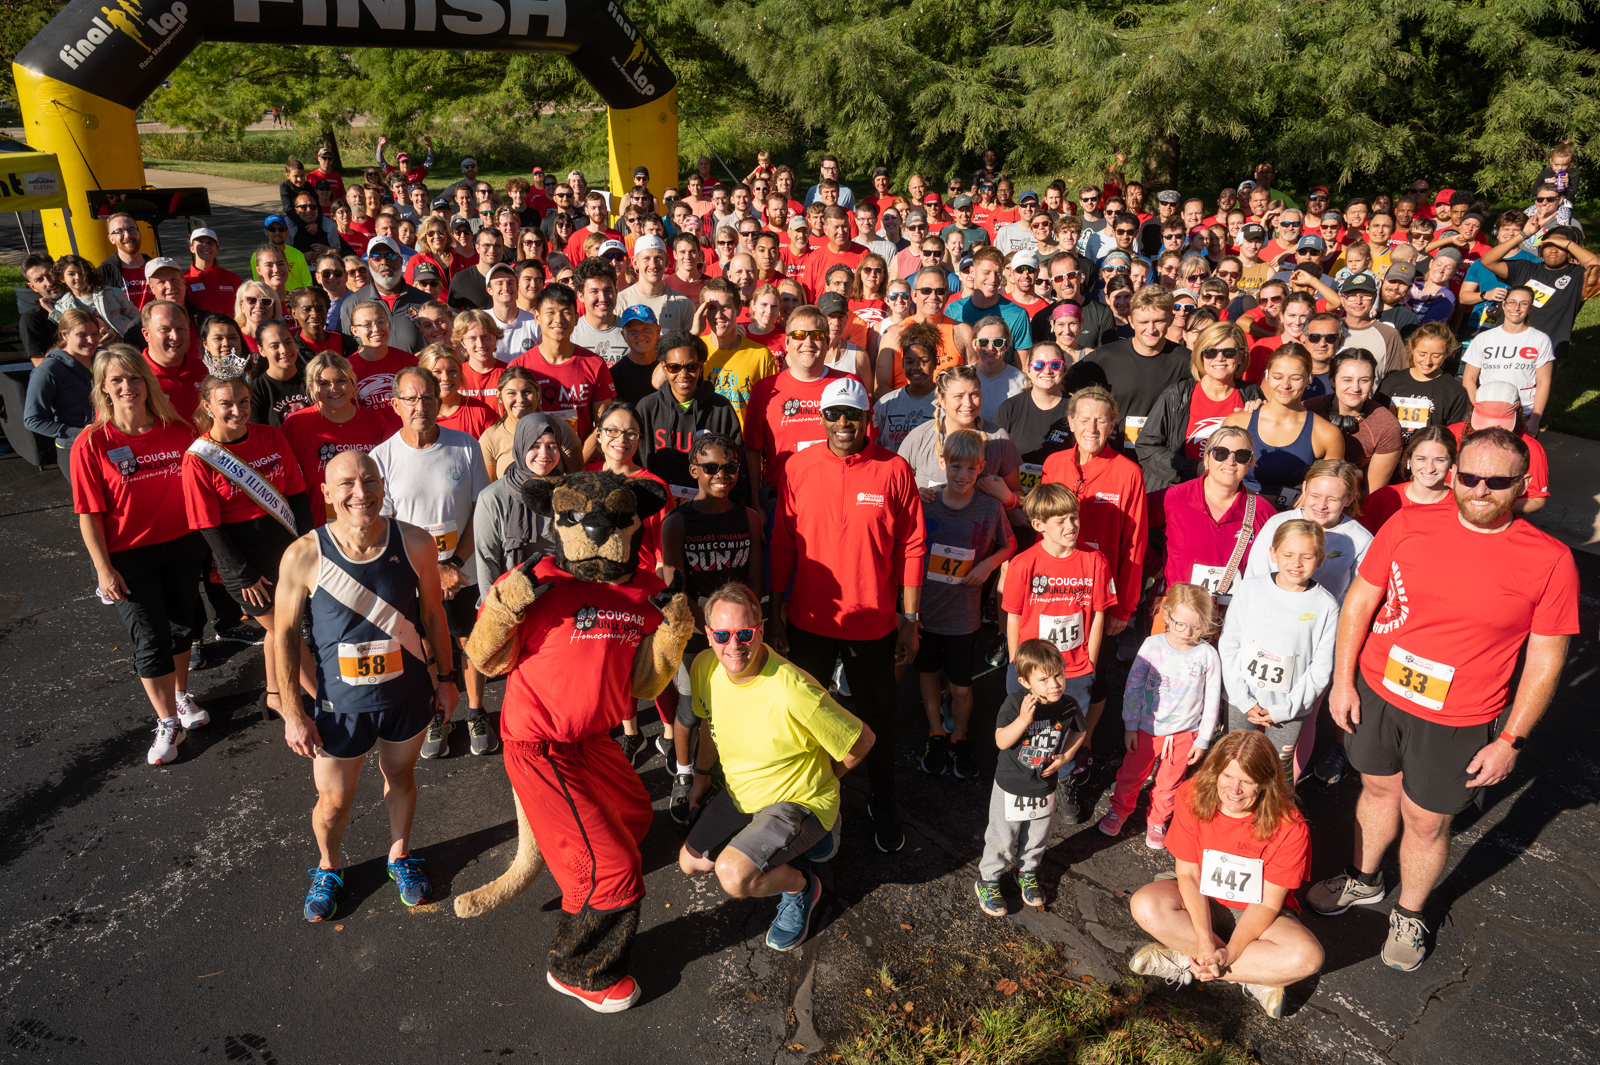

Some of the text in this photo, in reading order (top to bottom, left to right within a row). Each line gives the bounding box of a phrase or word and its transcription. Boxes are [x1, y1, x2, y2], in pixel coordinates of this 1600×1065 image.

[146, 1, 188, 37] lap
[607, 1, 637, 42] final
[59, 16, 115, 70] final
[139, 23, 186, 70] Race Management
[633, 65, 655, 96] lap
[1483, 346, 1539, 360] SIUe
[1395, 407, 1421, 422] 116
[654, 428, 692, 453] SIU
[1054, 429, 1069, 437] TOUR
[218, 456, 246, 479] MISS
[245, 475, 280, 509] ILLINOIS
[685, 534, 716, 543] OUGARS
[941, 558, 963, 576] 47
[1048, 577, 1094, 587] COUGARS
[1048, 586, 1092, 595] UNLEASHED
[1030, 593, 1076, 606] Homecoming
[597, 609, 646, 626] COUGARS
[597, 619, 645, 635] UNLEASHED
[569, 628, 627, 645] Homecoming
[1047, 624, 1080, 644] 415
[357, 654, 386, 676] 58
[1247, 659, 1285, 684] 413
[1398, 666, 1428, 694] 33
[1026, 719, 1051, 730] OUND
[1031, 730, 1061, 753] I'M 3
[1210, 866, 1252, 892] 447
